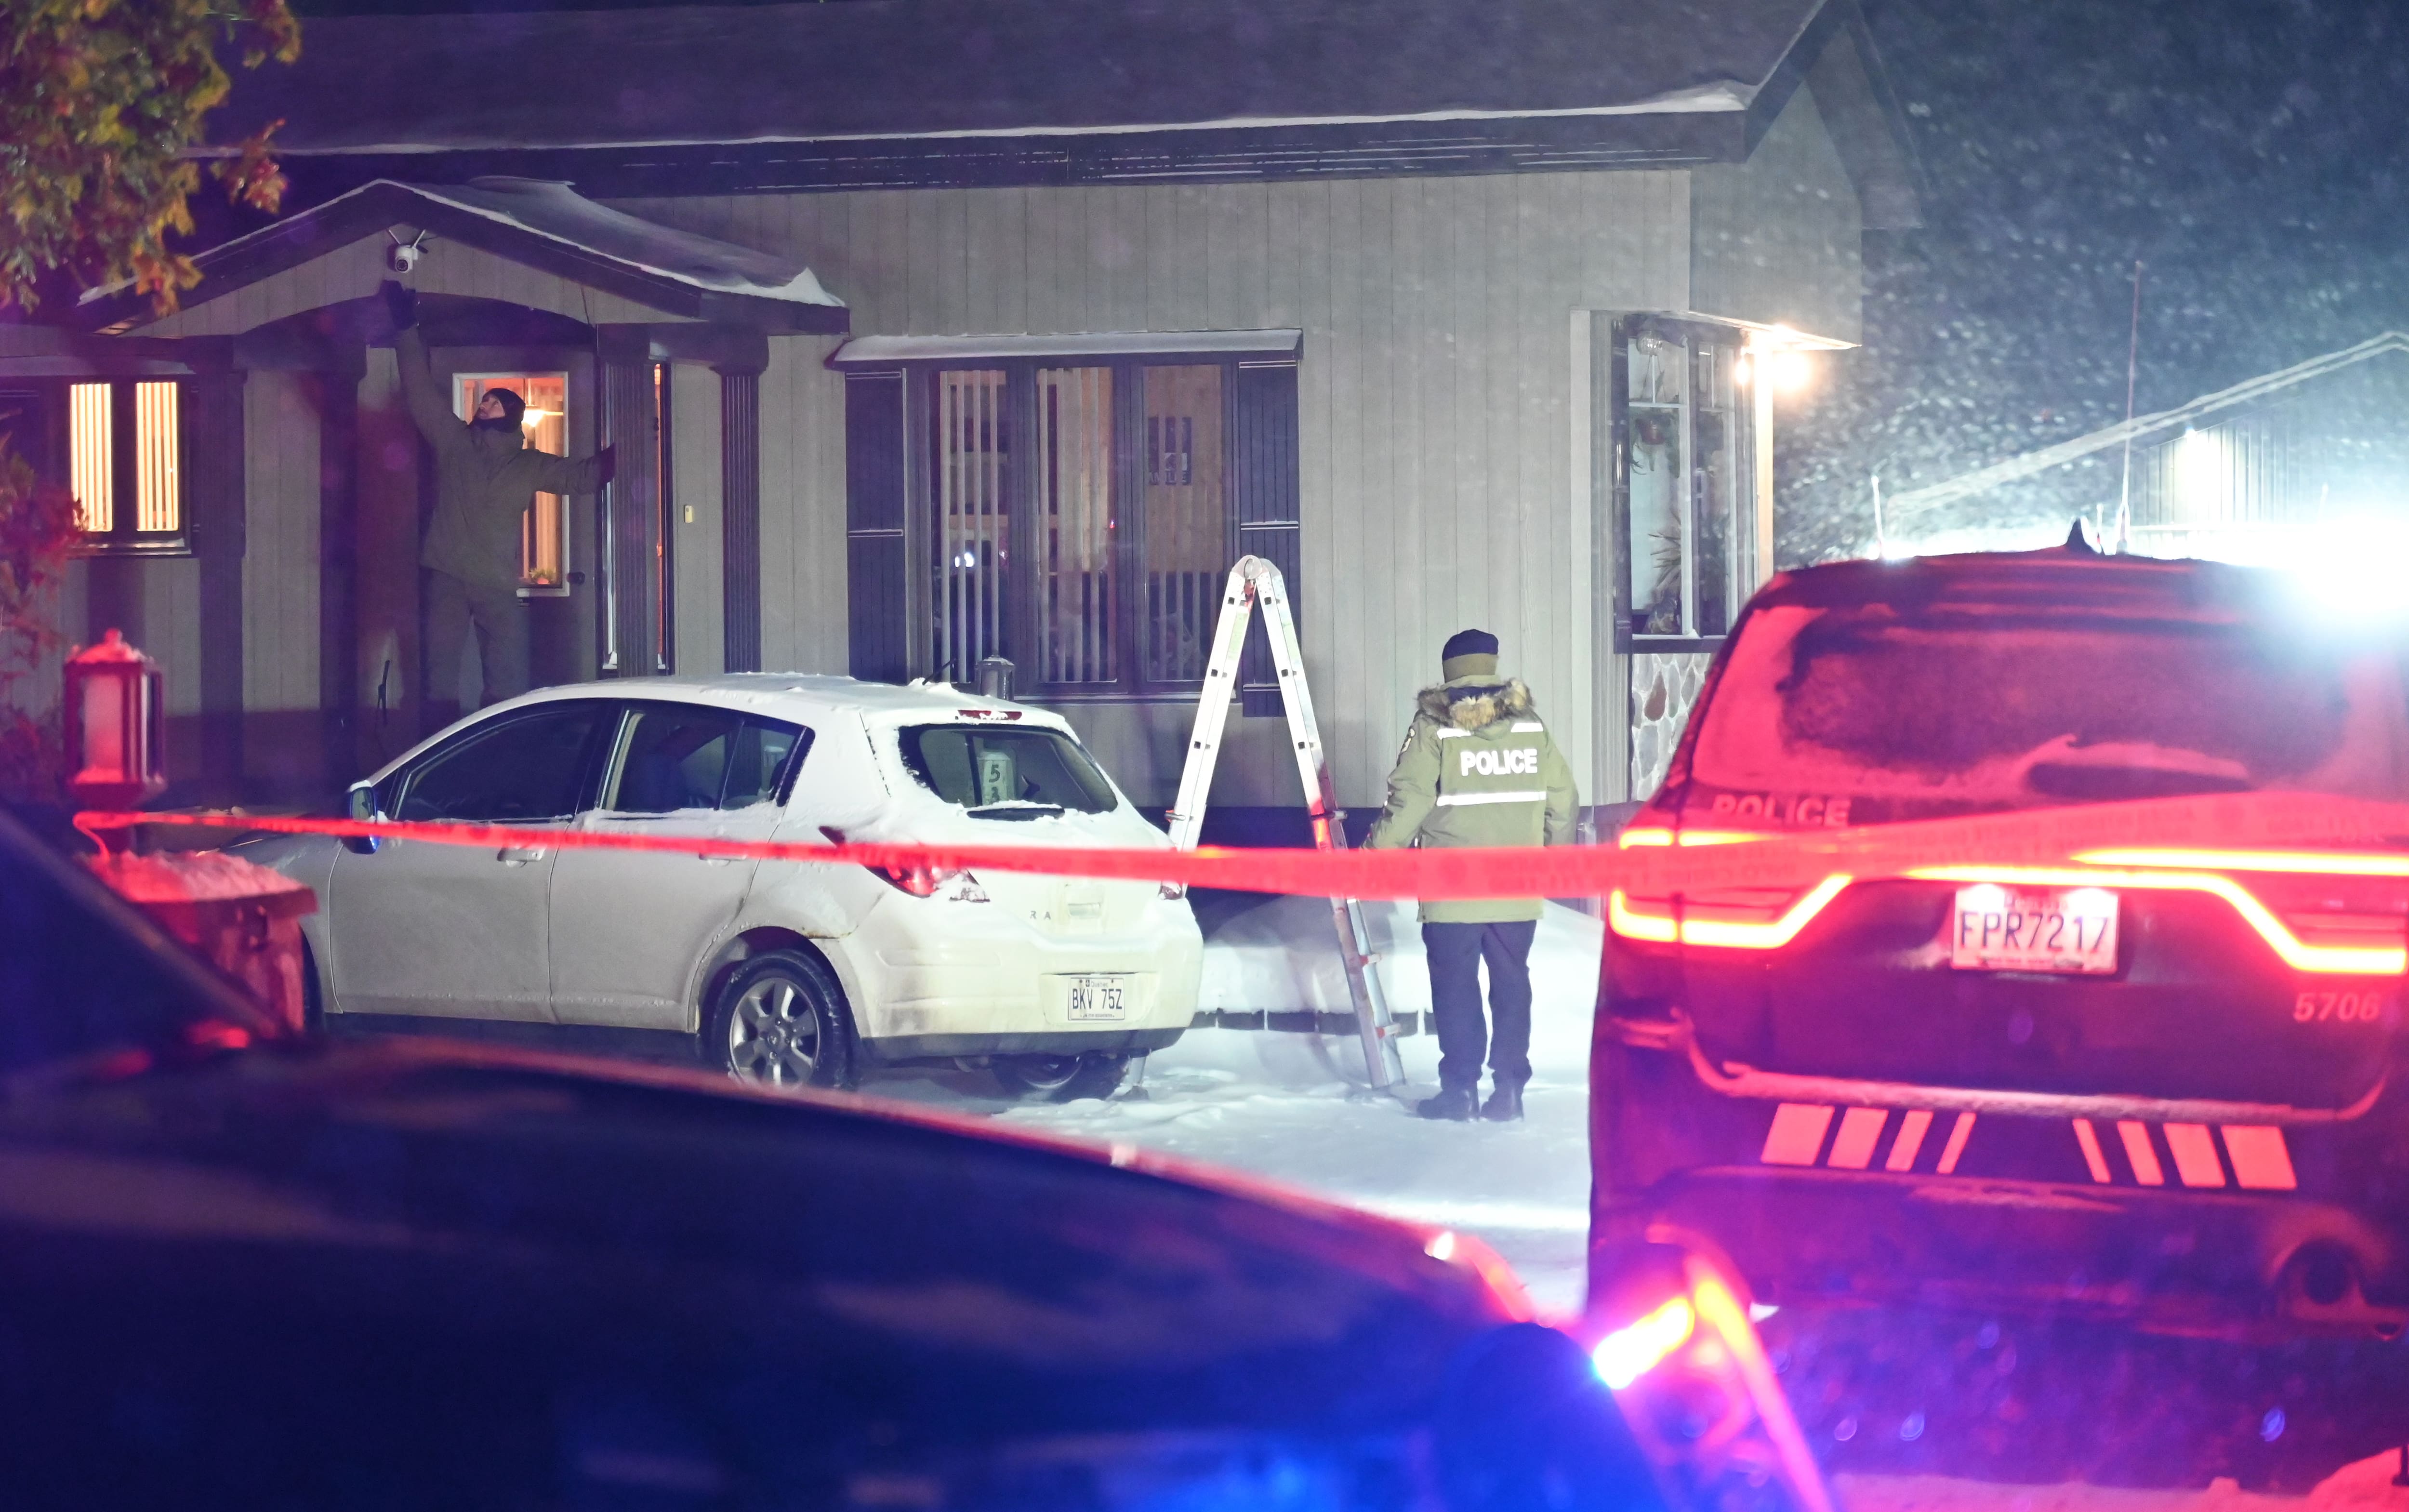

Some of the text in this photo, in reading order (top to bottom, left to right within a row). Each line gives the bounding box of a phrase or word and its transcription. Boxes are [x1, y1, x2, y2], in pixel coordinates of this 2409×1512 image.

[1460, 749, 1537, 776] POLICE
[1711, 794, 1851, 827] POLICE
[1961, 910, 2108, 951] FPR7217
[1072, 988, 1122, 1009] BKV 75Z
[2293, 992, 2382, 1021] 5706
